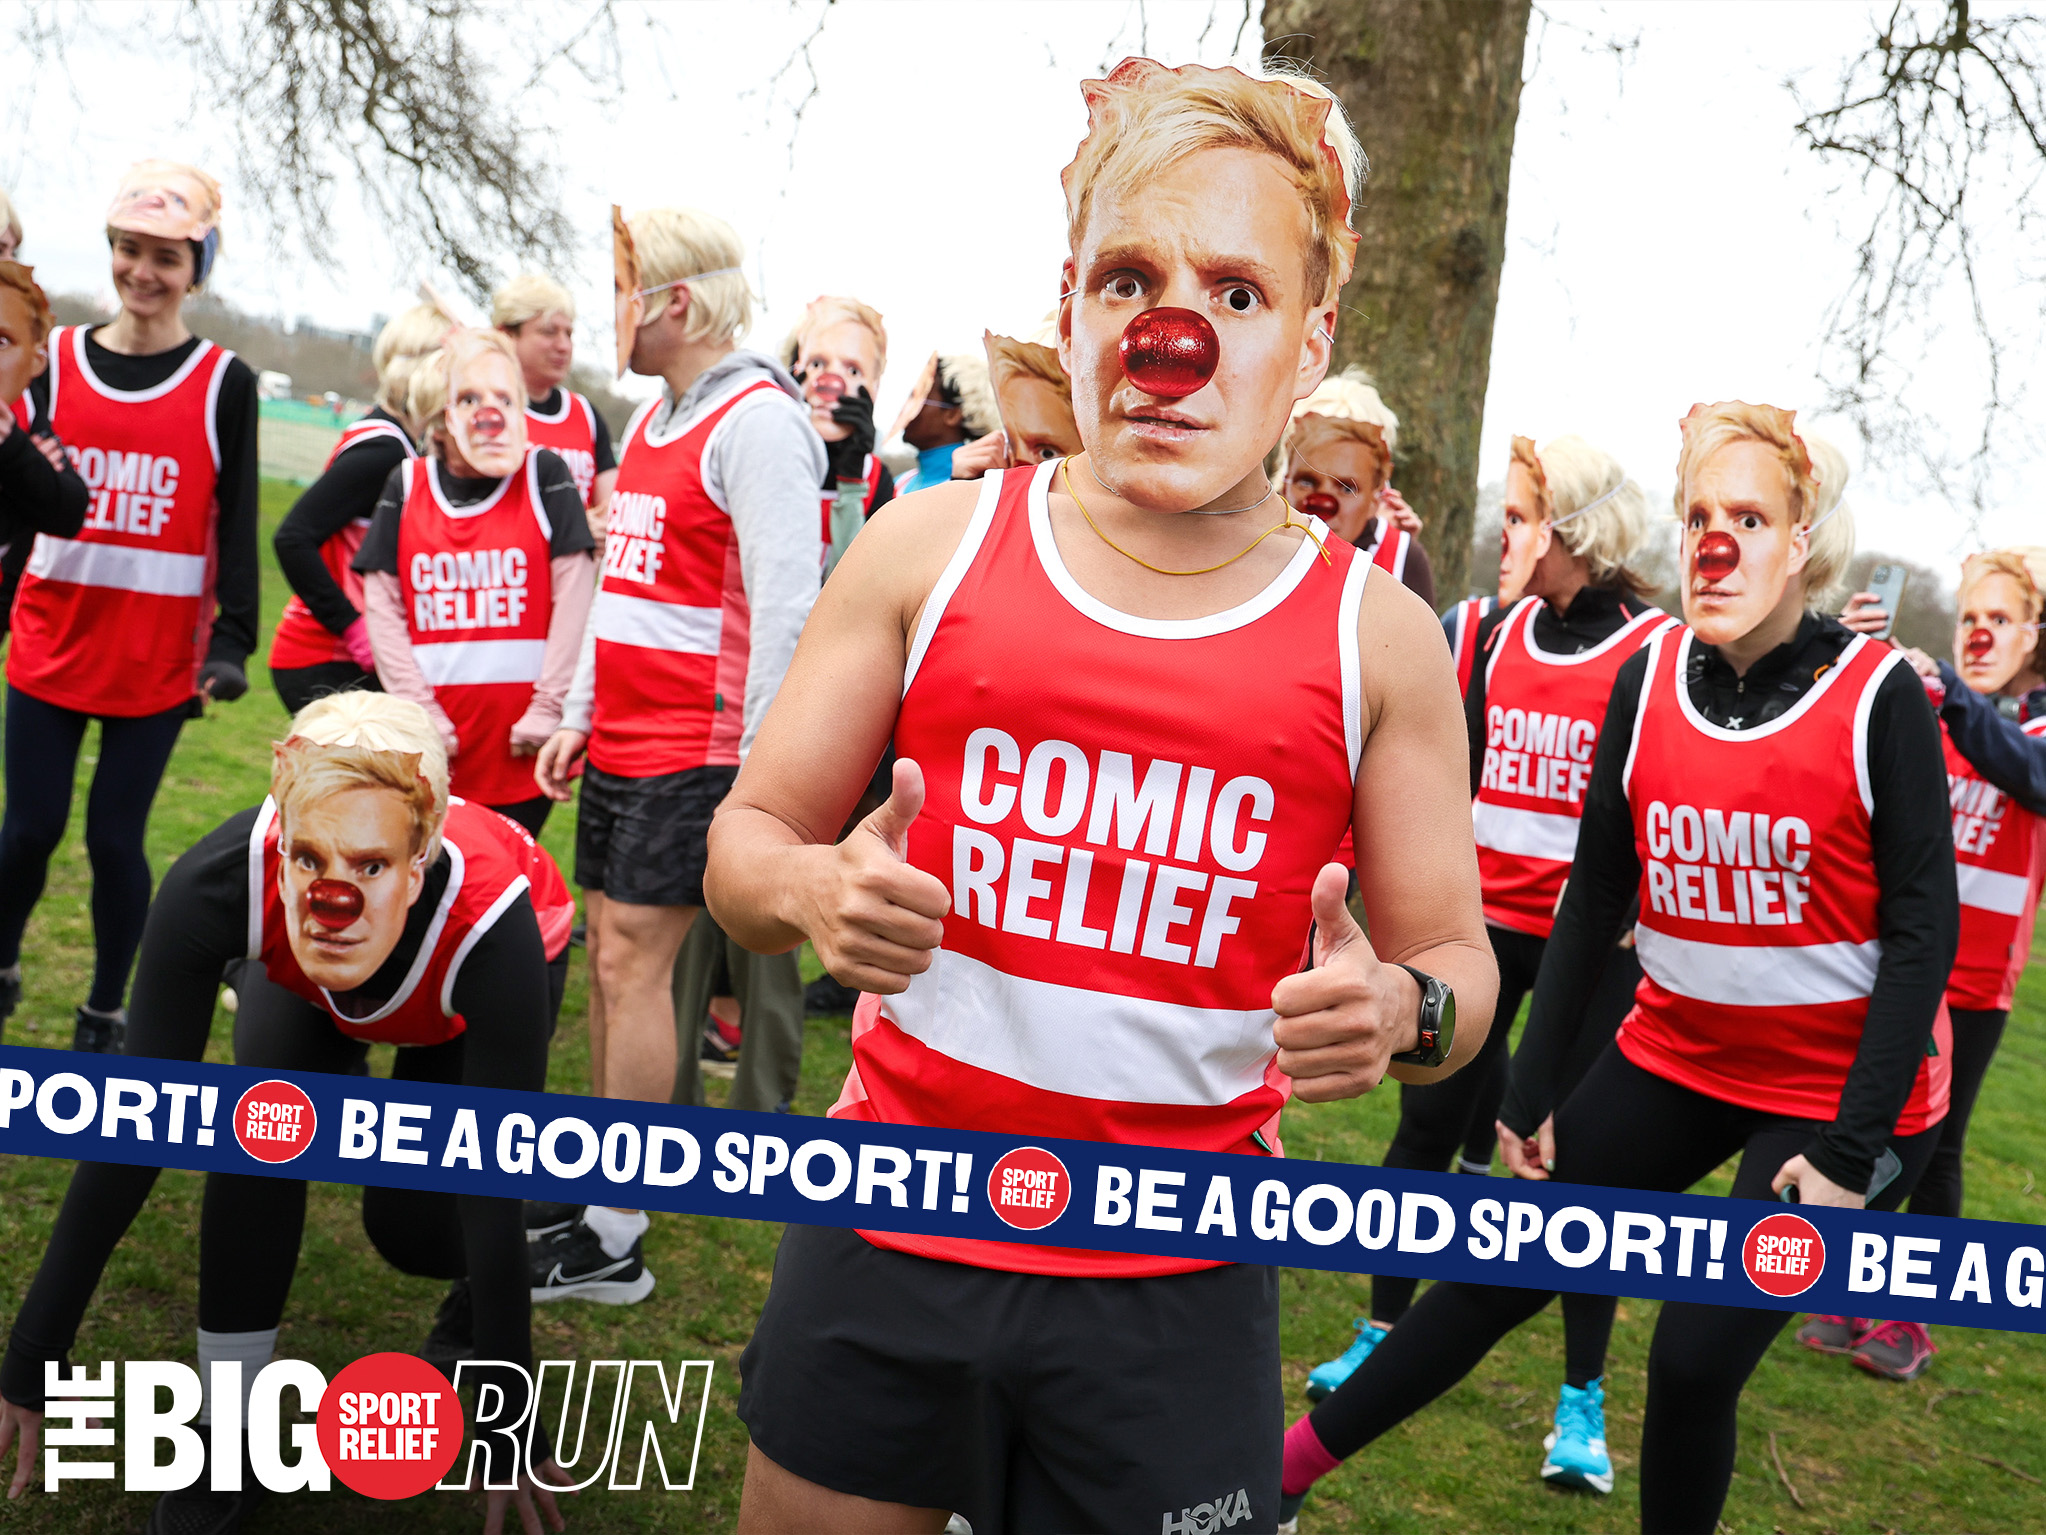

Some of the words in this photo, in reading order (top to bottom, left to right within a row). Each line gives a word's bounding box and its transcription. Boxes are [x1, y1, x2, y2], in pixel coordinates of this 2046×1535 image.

[83, 488, 176, 537] ELIEF
[410, 547, 528, 593] COMIC
[414, 587, 528, 632] RELIEF
[1488, 705, 1596, 762] COMIC
[961, 728, 1275, 871] COMIC
[1481, 747, 1592, 803] RELIEF
[1947, 773, 2008, 820] MIC
[1646, 800, 1811, 872] COMIC
[953, 825, 1259, 968] RELIEF
[1647, 858, 1811, 926] RELIEF
[1162, 1488, 1253, 1535] HOKA
